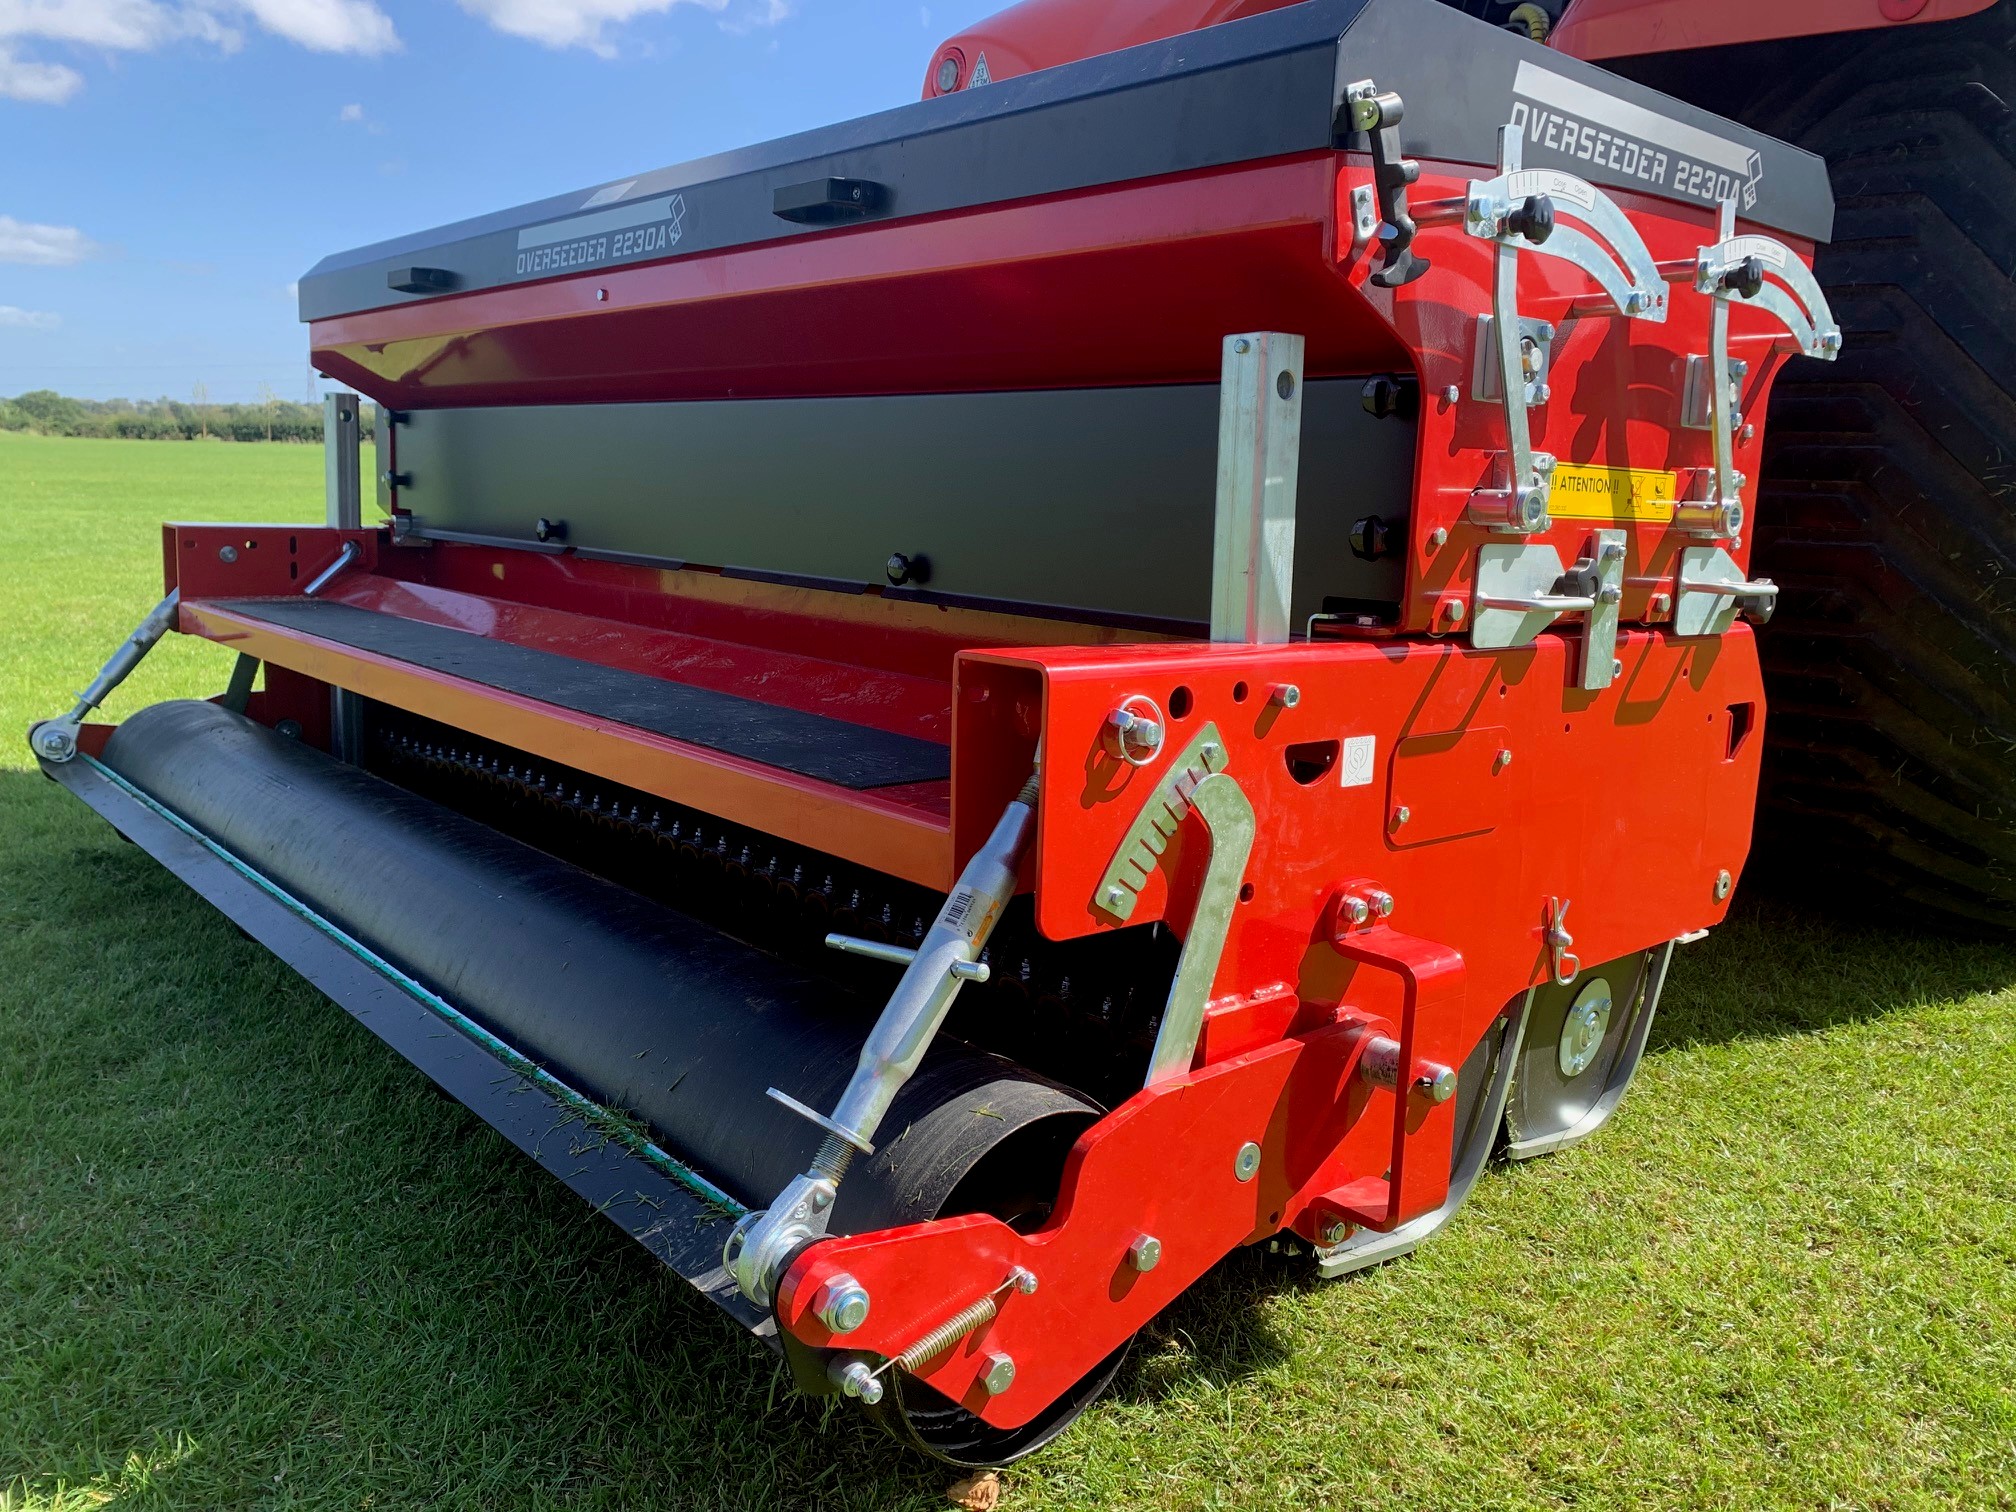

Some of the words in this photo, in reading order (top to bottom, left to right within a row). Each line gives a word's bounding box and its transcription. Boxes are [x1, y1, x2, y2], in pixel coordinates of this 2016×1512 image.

[1510, 101, 1668, 184] OVERSEEDER
[1673, 160, 1741, 208] 2230A
[516, 237, 607, 275] OVERSEEDER
[612, 225, 666, 258] 2230A
[1560, 476, 1611, 493] ATTENTION
